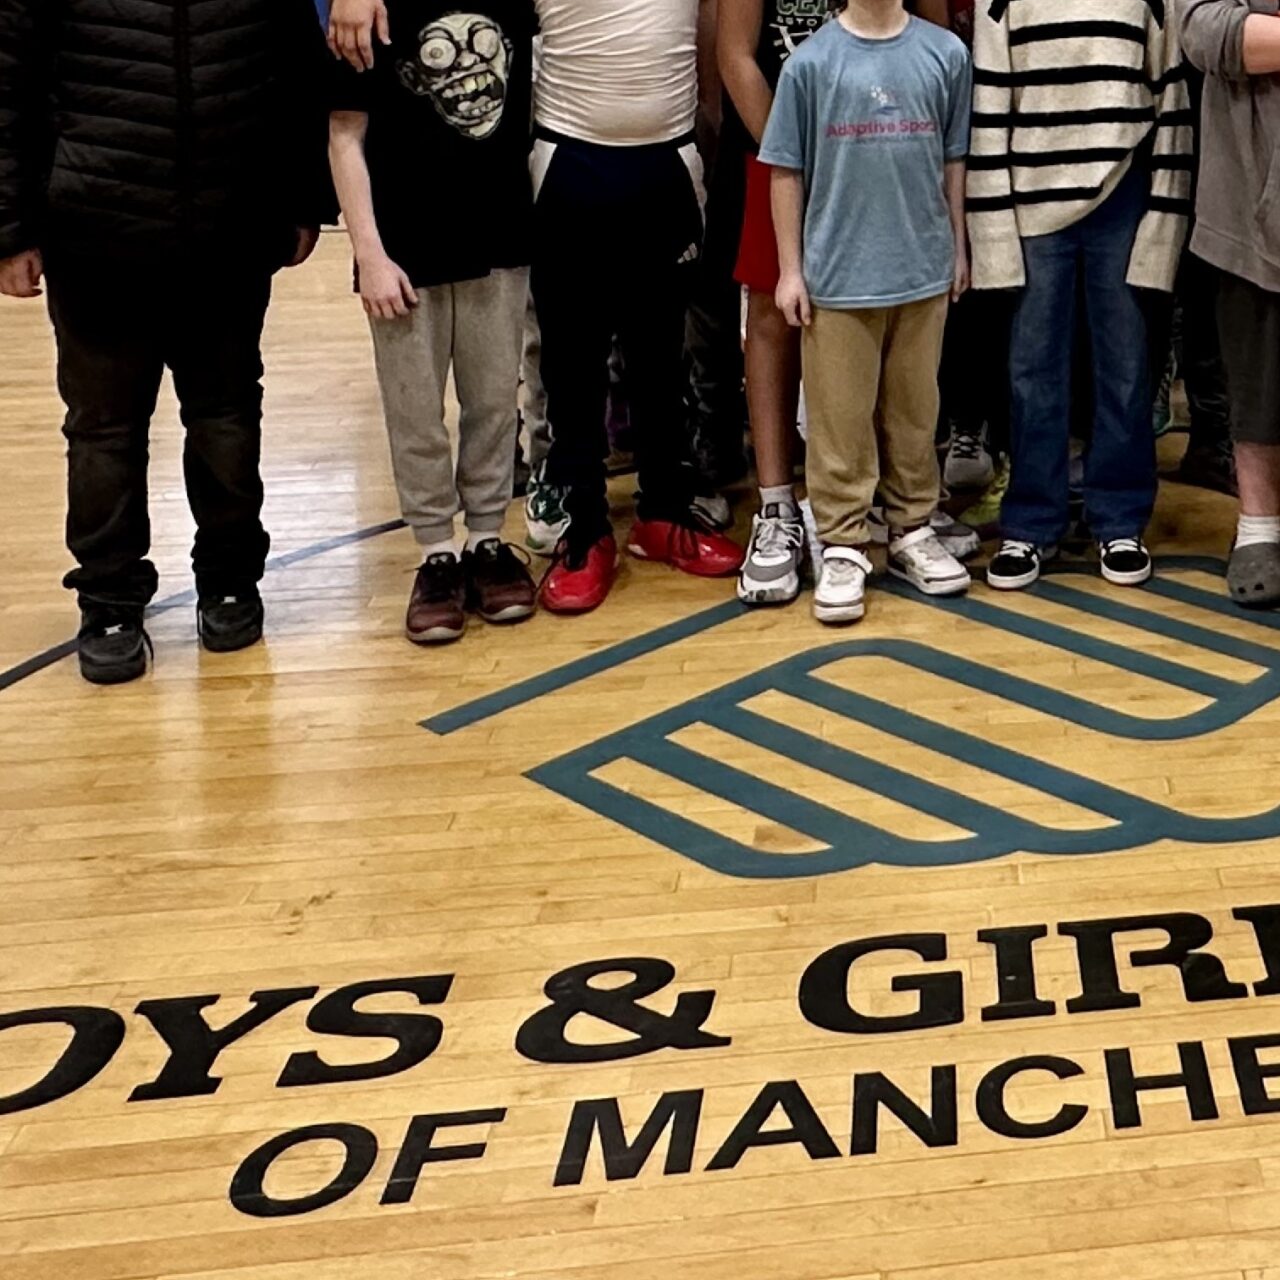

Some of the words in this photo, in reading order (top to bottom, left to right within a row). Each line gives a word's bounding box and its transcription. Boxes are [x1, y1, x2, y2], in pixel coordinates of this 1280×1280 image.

[825, 120, 897, 138] Adaptive
[515, 957, 732, 1064] &
[229, 1107, 508, 1218] OF
